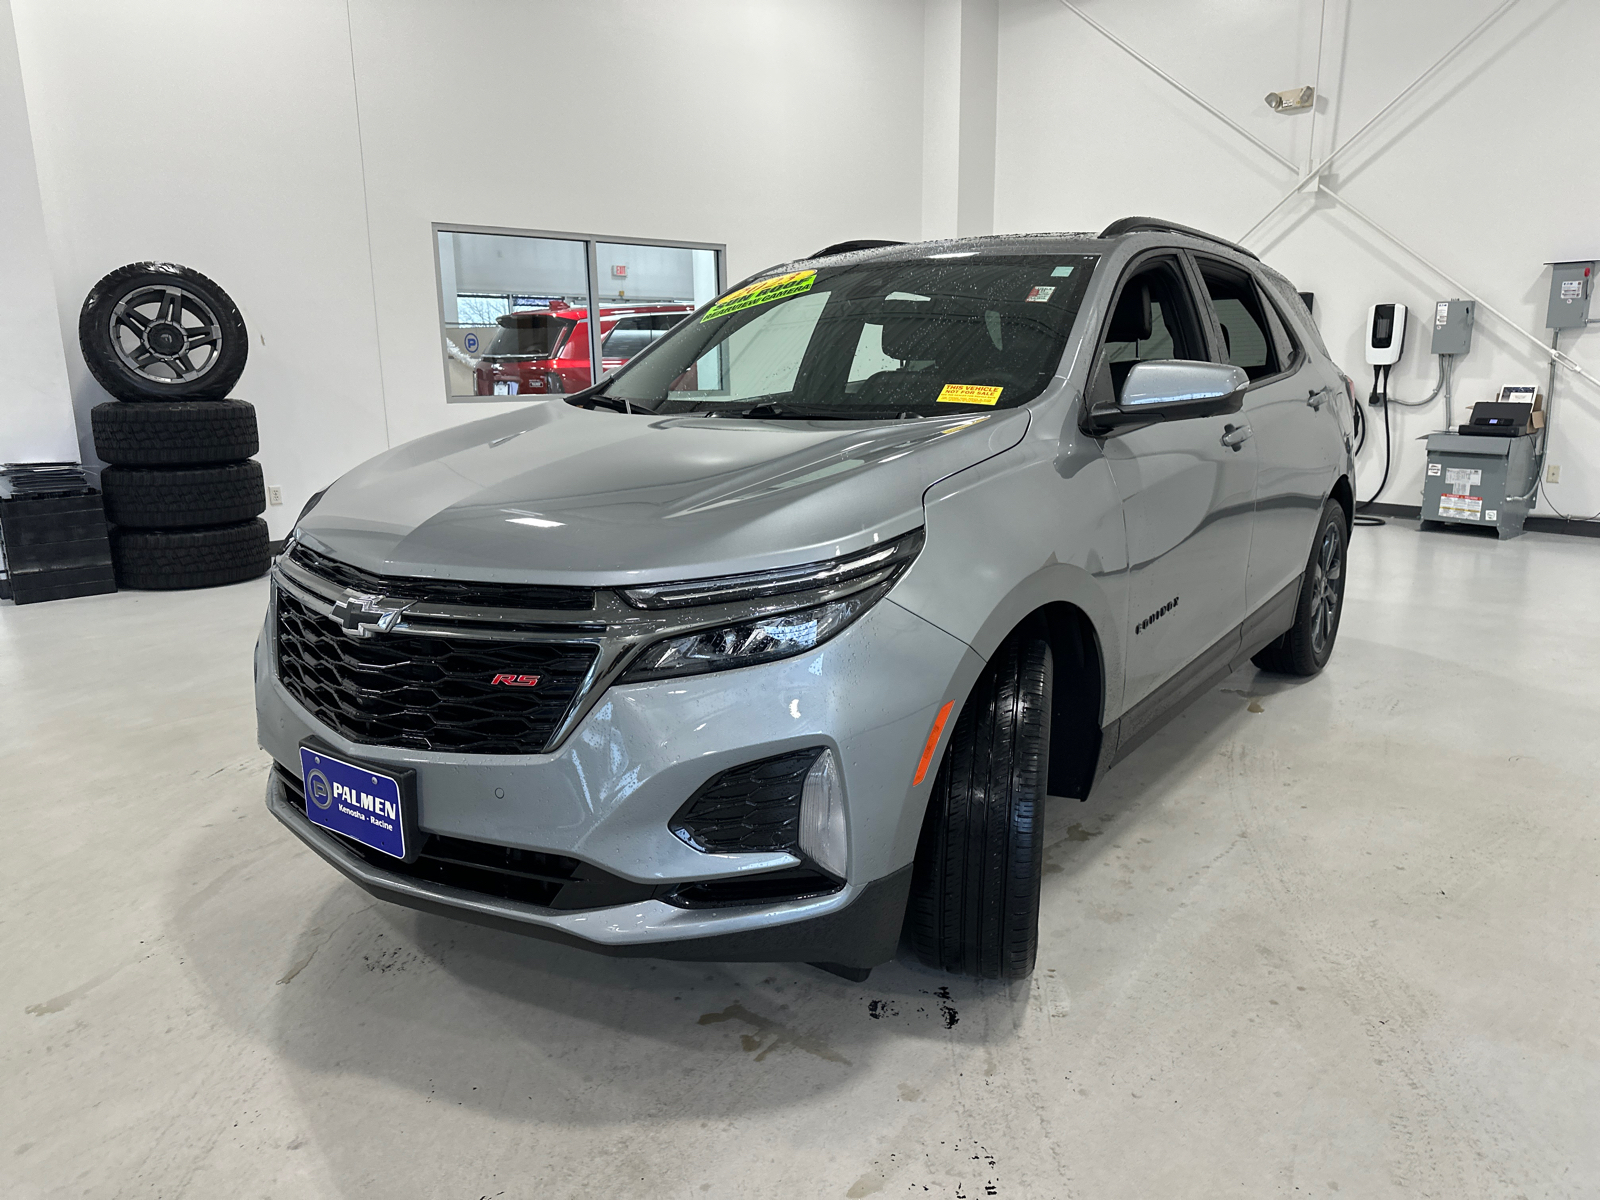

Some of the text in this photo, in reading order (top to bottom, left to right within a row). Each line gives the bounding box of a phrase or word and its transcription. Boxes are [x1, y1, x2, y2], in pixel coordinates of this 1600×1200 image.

[491, 674, 540, 686] RS
[332, 781, 396, 821] PALMEN
[338, 803, 366, 821] Kenosha
[370, 816, 393, 832] Racine
